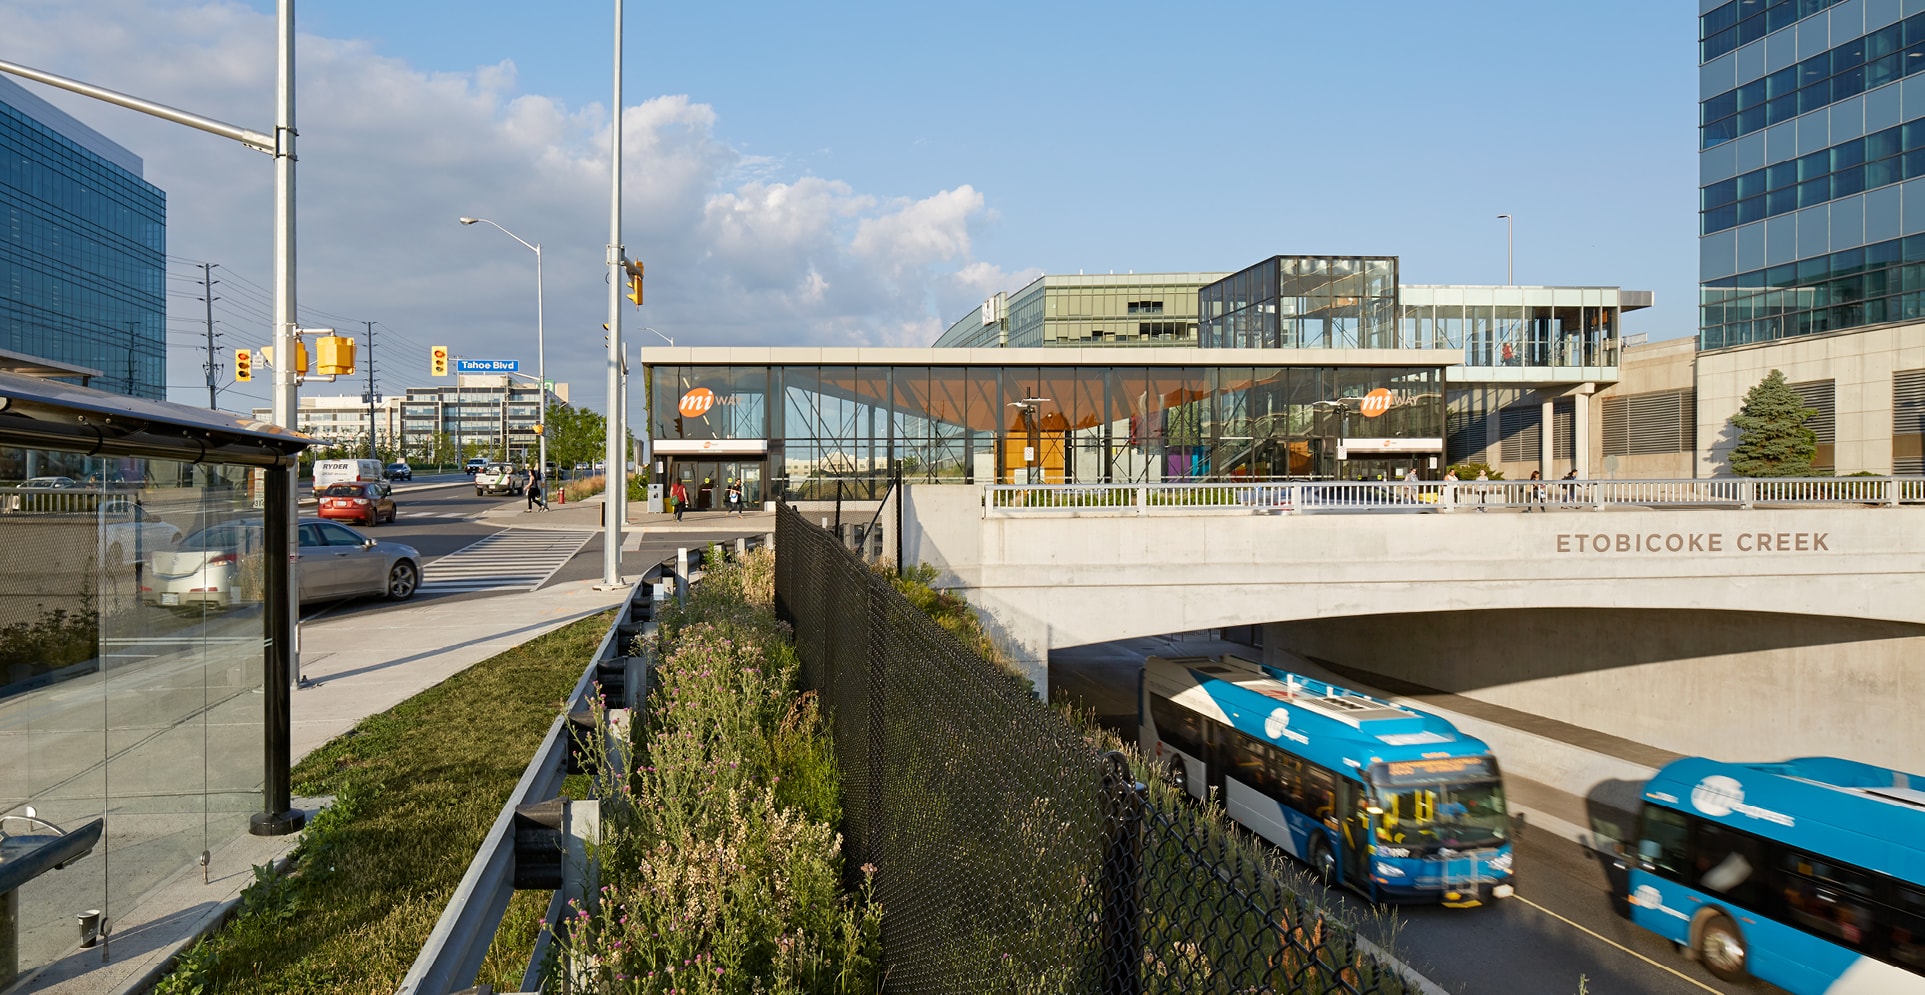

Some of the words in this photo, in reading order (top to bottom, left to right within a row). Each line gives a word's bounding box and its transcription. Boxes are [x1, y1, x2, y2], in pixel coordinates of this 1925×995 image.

[462, 361, 491, 369] Tahoe
[493, 361, 514, 369] Blvd
[1556, 533, 1723, 553] ETOBICOKE
[1736, 532, 1830, 551] CREEK
